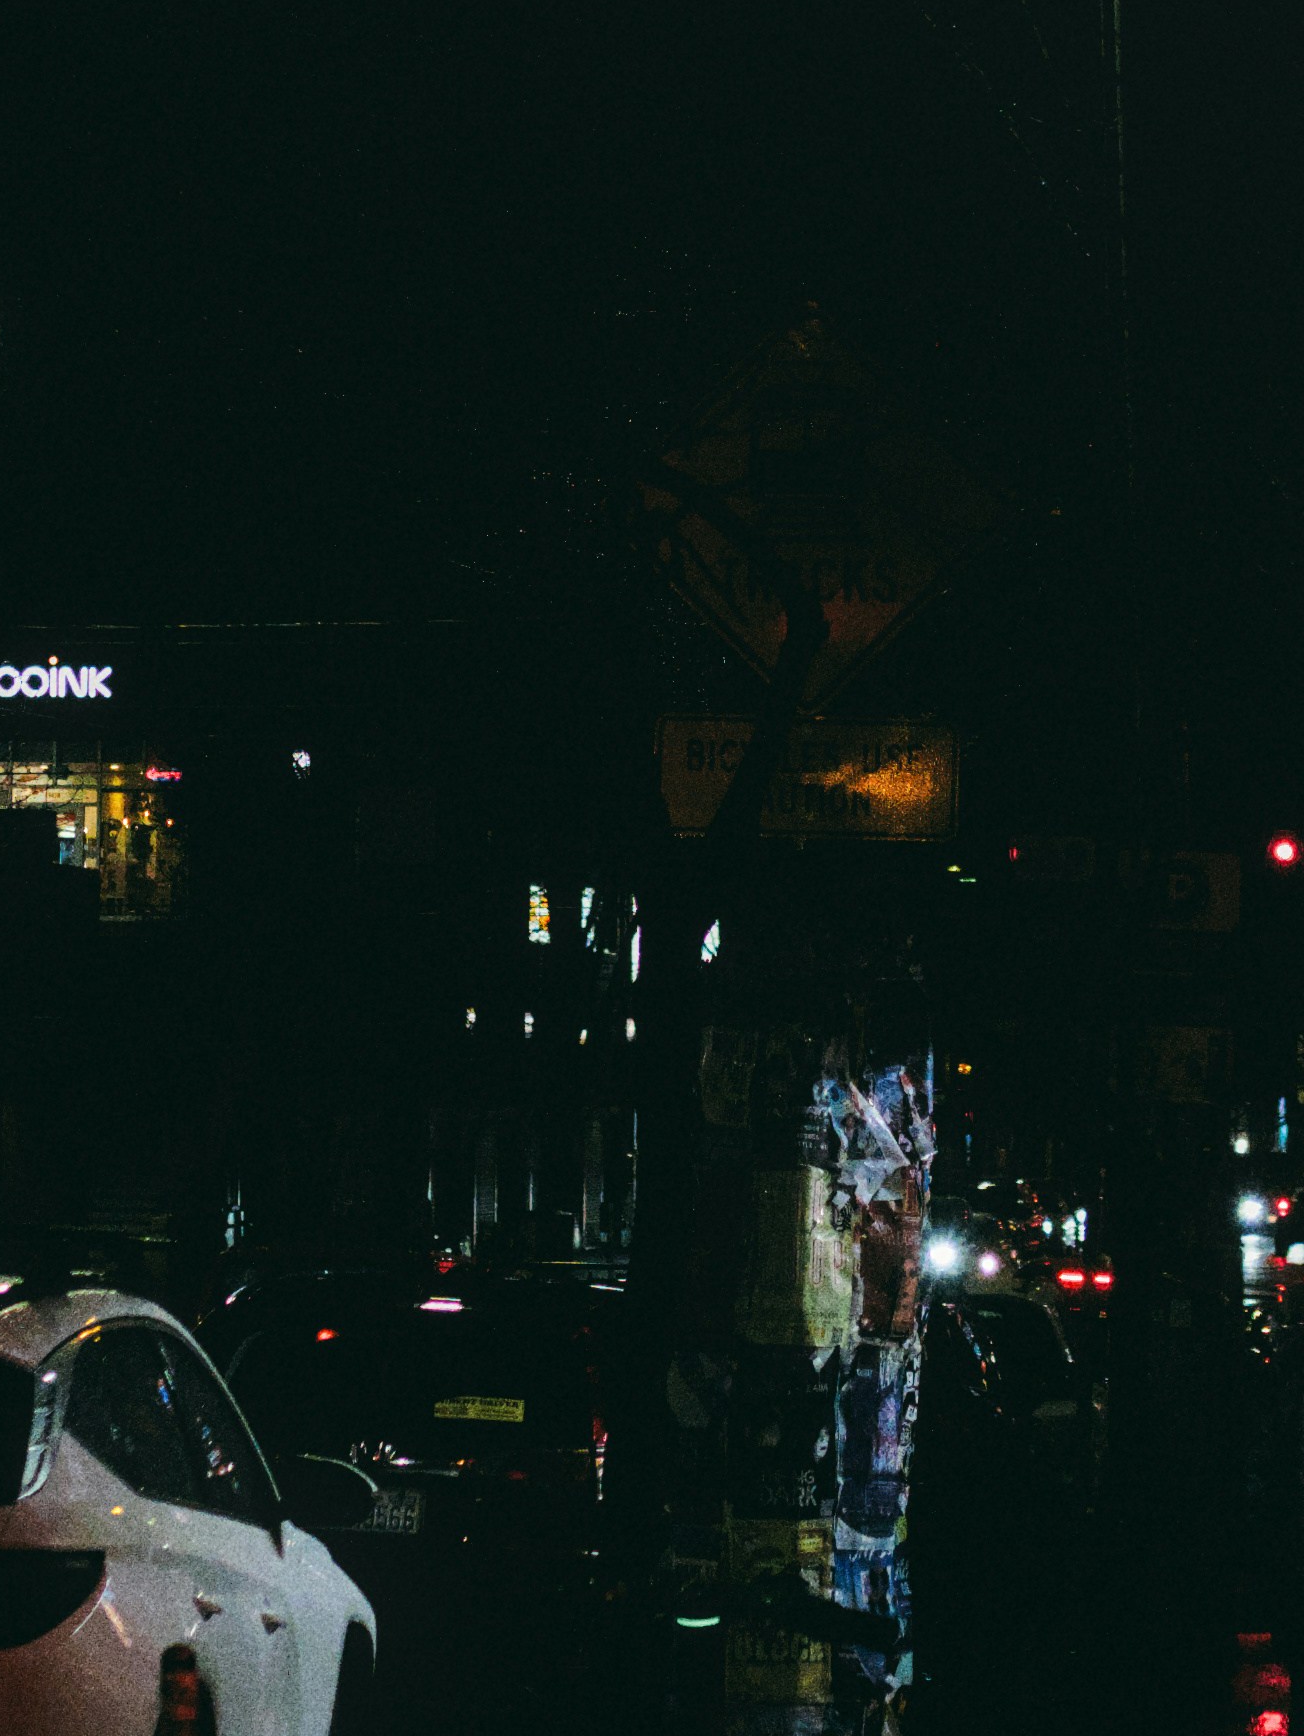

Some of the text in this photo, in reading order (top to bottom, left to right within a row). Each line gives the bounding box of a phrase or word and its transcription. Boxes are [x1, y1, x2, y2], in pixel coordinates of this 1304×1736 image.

[719, 556, 896, 602] TRCKS
[686, 739, 839, 774] BICLES
[746, 783, 872, 816] AUTION
